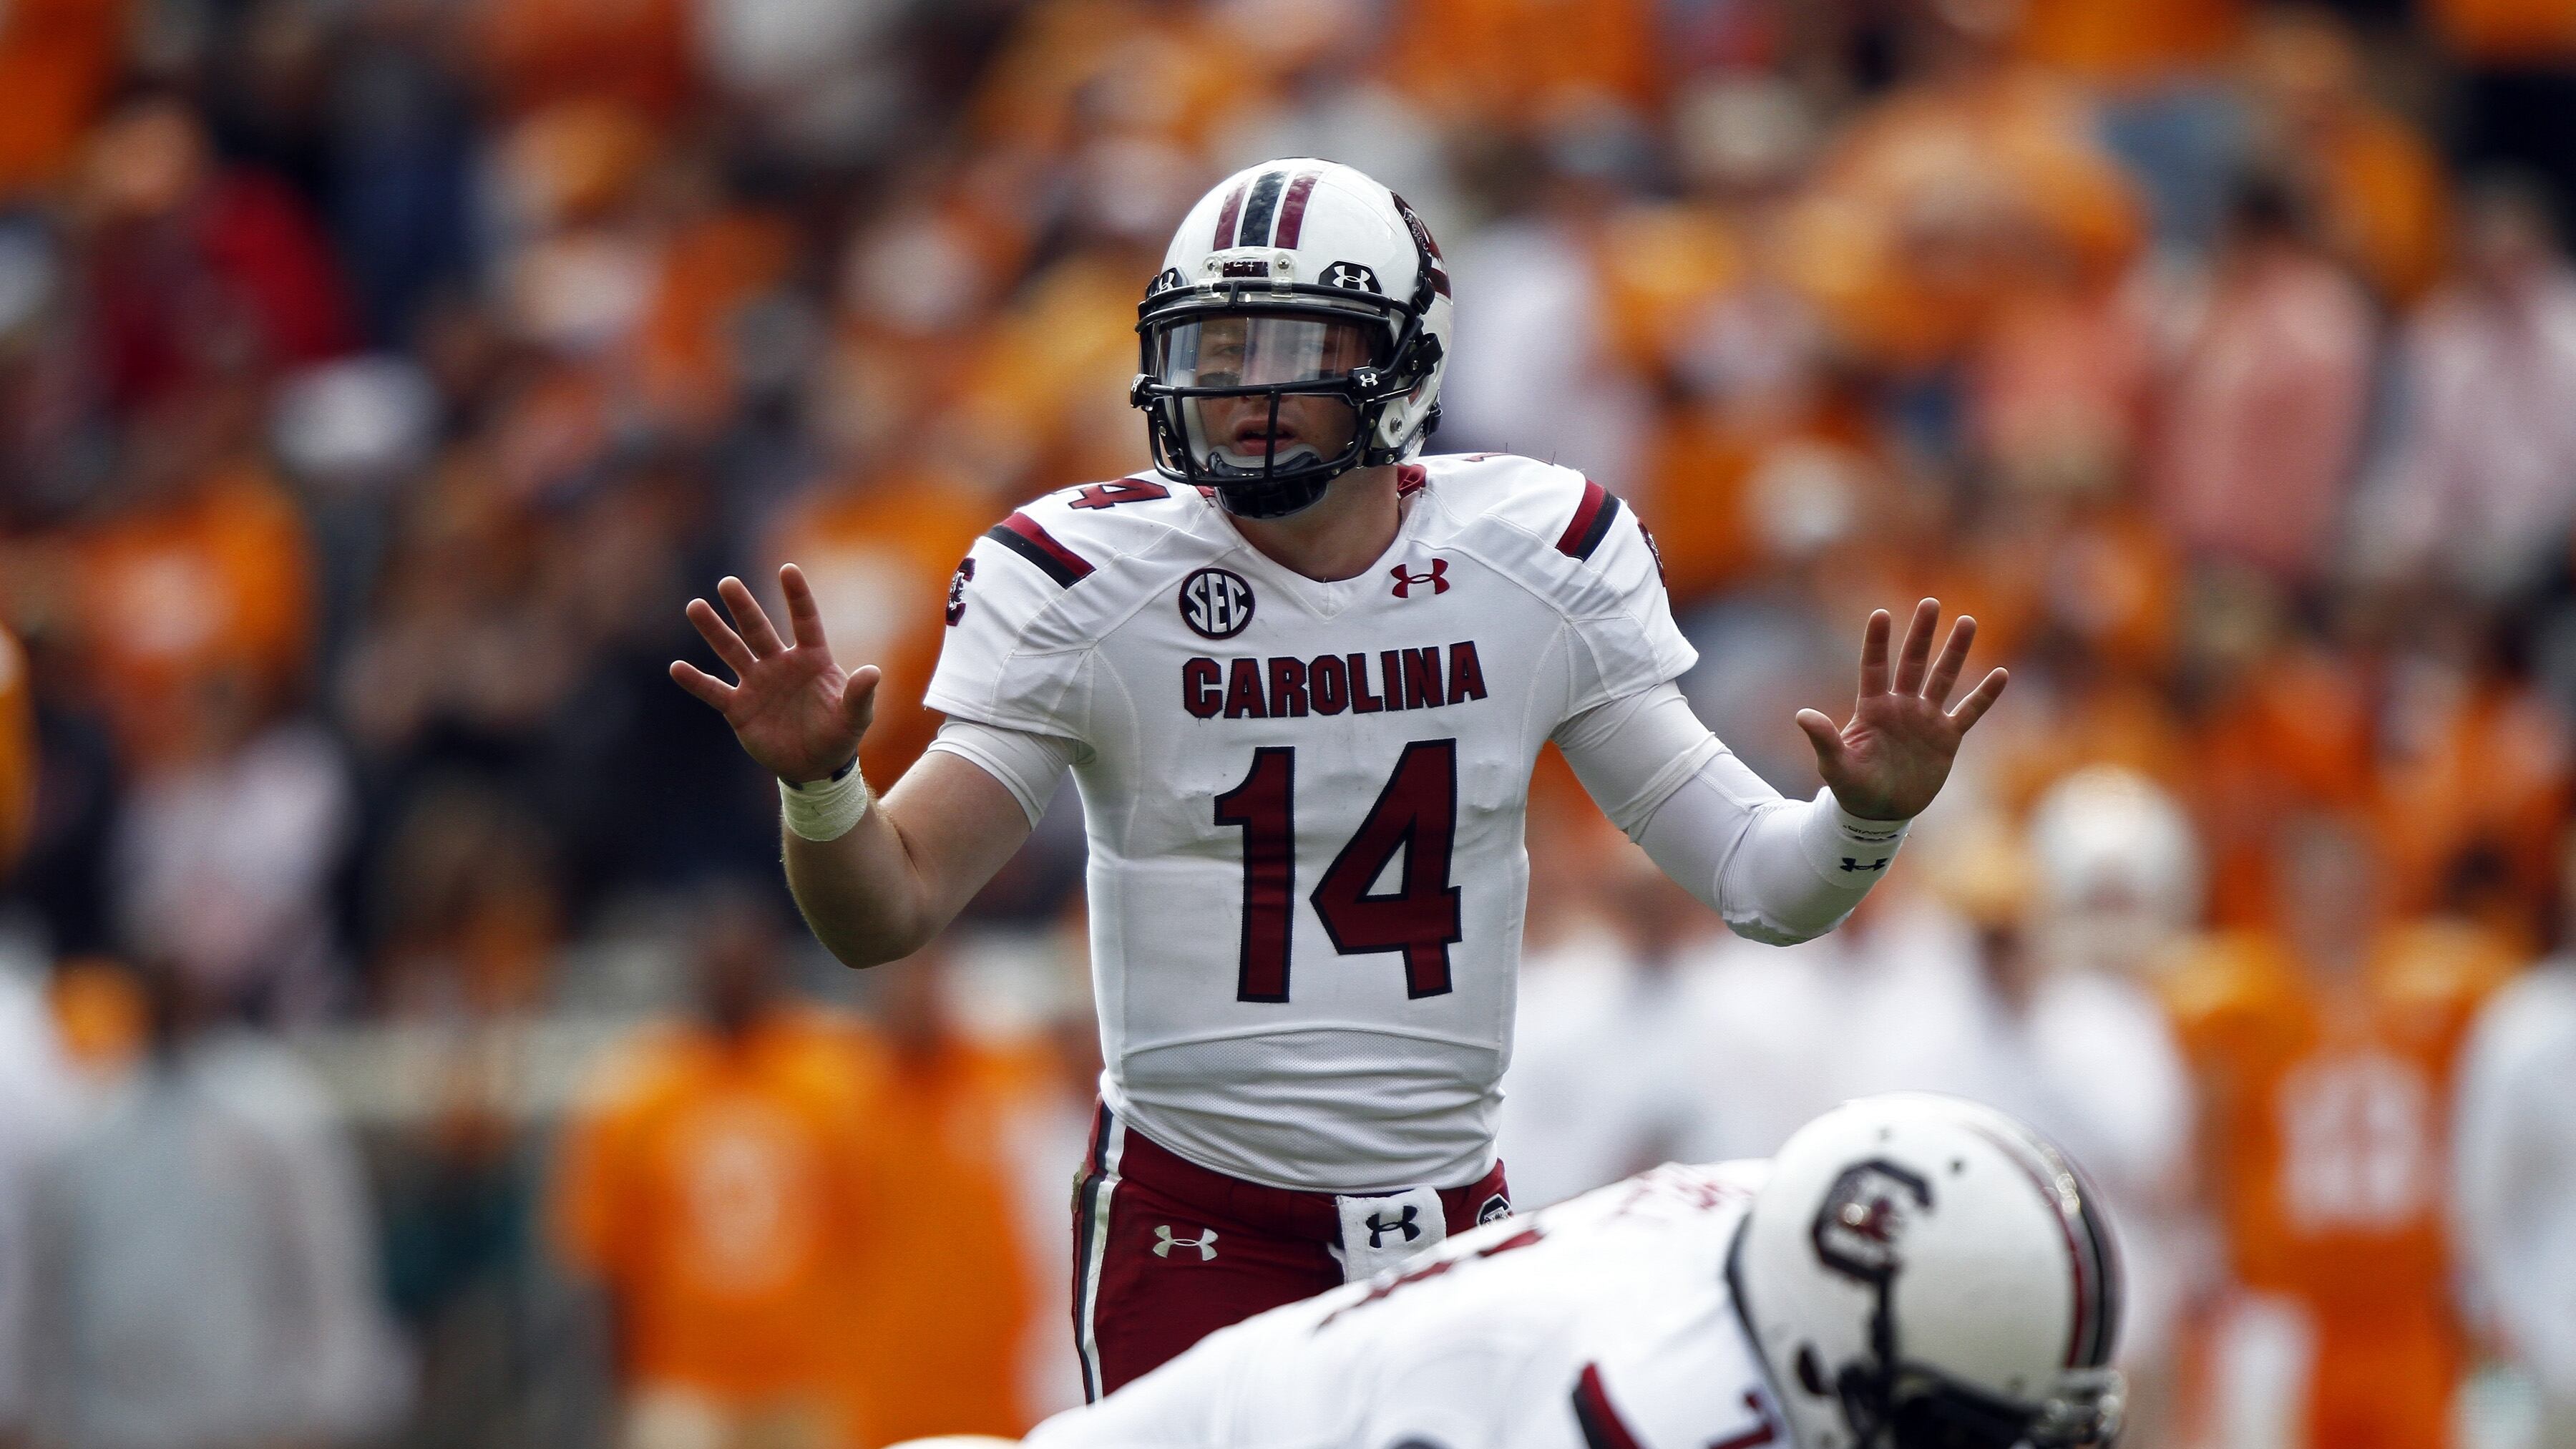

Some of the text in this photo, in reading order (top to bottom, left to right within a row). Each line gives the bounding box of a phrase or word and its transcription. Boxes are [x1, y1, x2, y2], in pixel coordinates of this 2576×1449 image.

[1186, 572, 1249, 633] SEC
[1182, 640, 1488, 718] CAROLINA
[1214, 738, 1462, 1003] 14
